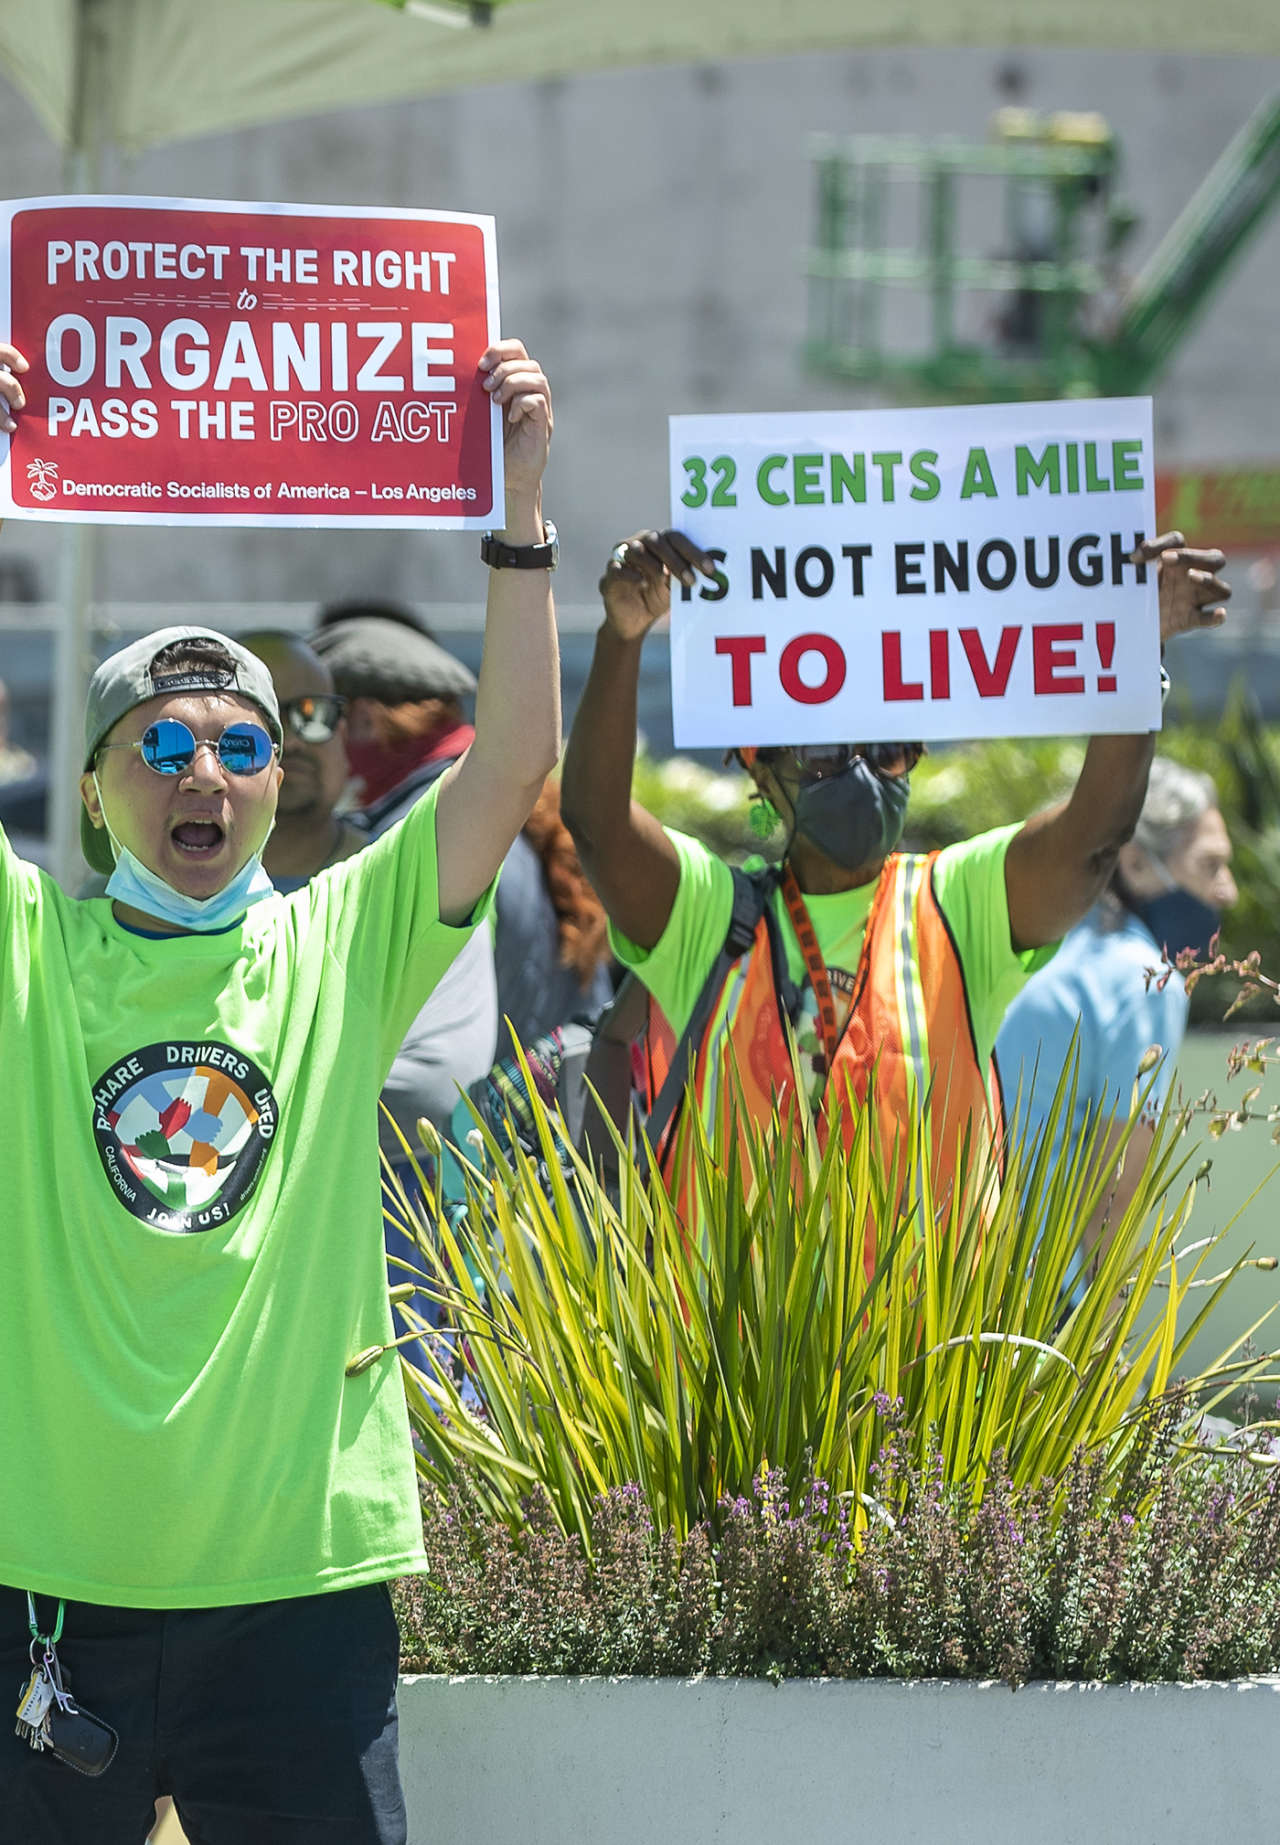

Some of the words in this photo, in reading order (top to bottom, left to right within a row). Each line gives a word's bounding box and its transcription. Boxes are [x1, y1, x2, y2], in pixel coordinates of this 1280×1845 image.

[47, 240, 230, 285] PROTECT
[240, 247, 319, 285] THE
[333, 250, 456, 295] RIGHT
[236, 288, 258, 312] to
[45, 312, 456, 394] ORGANIZE
[47, 396, 160, 439] PASS
[170, 400, 255, 441] THE
[269, 401, 360, 442] PRO
[370, 401, 457, 443] ACT
[62, 479, 163, 499] Democratic
[166, 481, 251, 500] Socialists
[254, 482, 272, 500] of
[276, 483, 351, 500] America
[371, 484, 404, 501] Los
[405, 484, 477, 504] Angeles
[680, 455, 738, 508] 32
[755, 448, 941, 507] CENTS
[959, 446, 999, 500] A
[1013, 439, 1145, 497] MILE
[750, 543, 873, 601] NOT
[894, 531, 1150, 596] ENOUGH
[714, 631, 847, 708] TO
[880, 620, 1118, 703] LIVE!
[166, 1046, 250, 1080] DRIVERS
[105, 1145, 137, 1202] CALIFORNIA
[198, 1202, 231, 1225] US!
